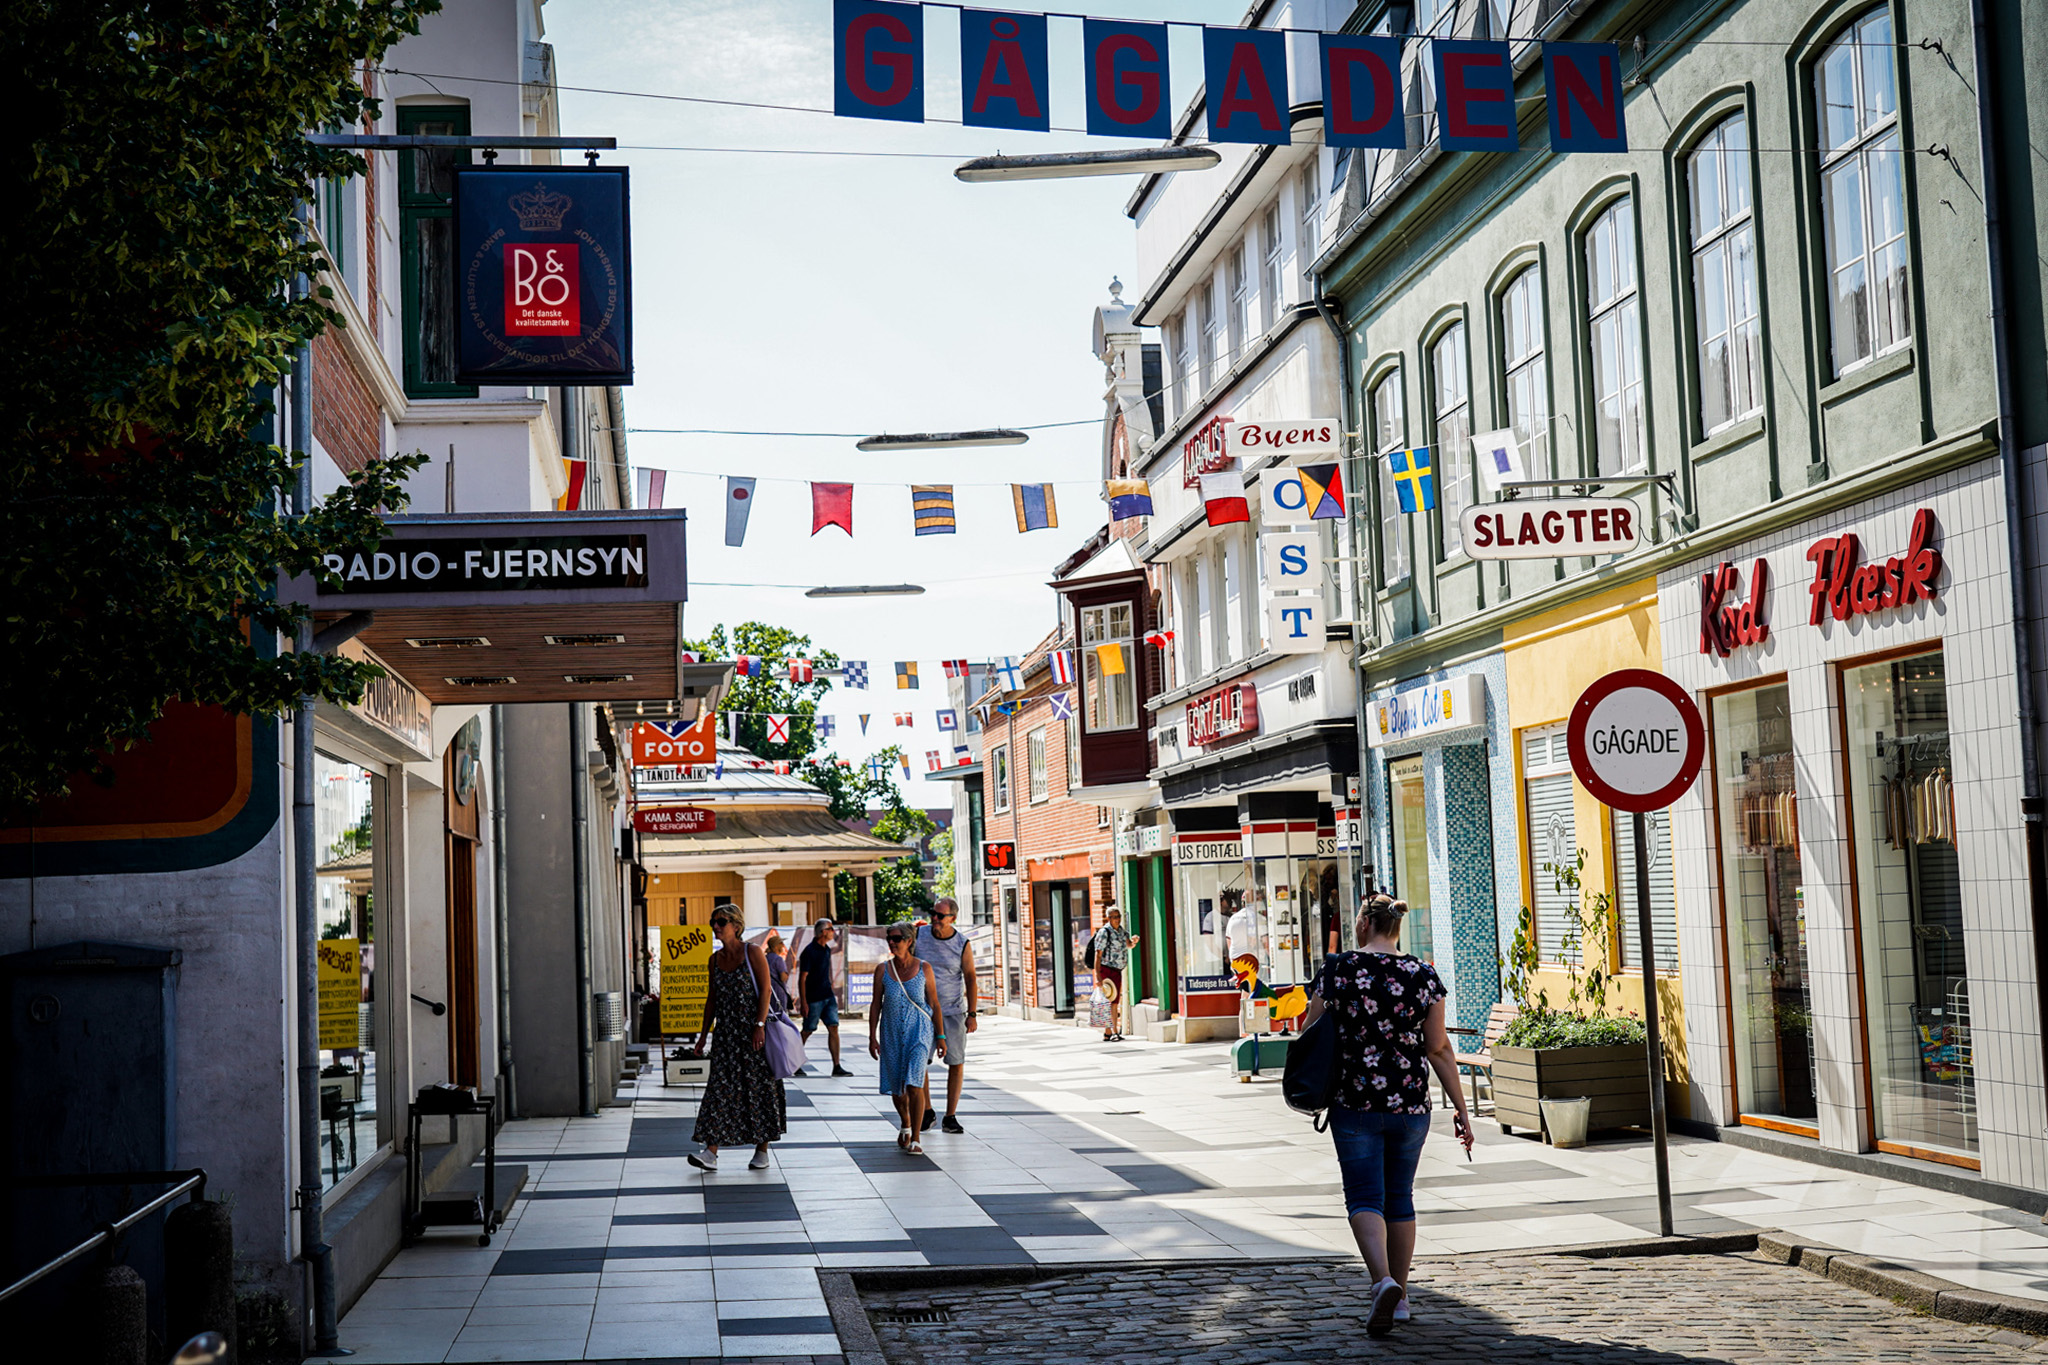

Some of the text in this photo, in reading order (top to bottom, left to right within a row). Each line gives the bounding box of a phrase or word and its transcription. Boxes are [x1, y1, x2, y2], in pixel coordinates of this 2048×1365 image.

[845, 12, 1618, 140] GÅGADEN
[481, 228, 505, 251] BANG
[574, 228, 595, 245] HOF
[467, 260, 480, 309] OLUFSEN
[515, 318, 570, 327] kvalitetsmærke
[522, 309, 562, 318] Det danske
[588, 288, 617, 346] KONGELIGE
[1238, 424, 1332, 448] Byens
[1473, 508, 1634, 547] SLAGTER
[1806, 507, 1943, 627] Flæsk
[1390, 685, 1441, 738] Byens Ost
[645, 740, 704, 758] FOTO
[1592, 724, 1681, 756] GÅGADE
[644, 811, 704, 823] KAMA SKILTE
[659, 823, 698, 831] SERIGRAFI
[984, 867, 1016, 876] interflora
[1188, 978, 1217, 990] Tidsrejse
[1218, 978, 1228, 988] fra
